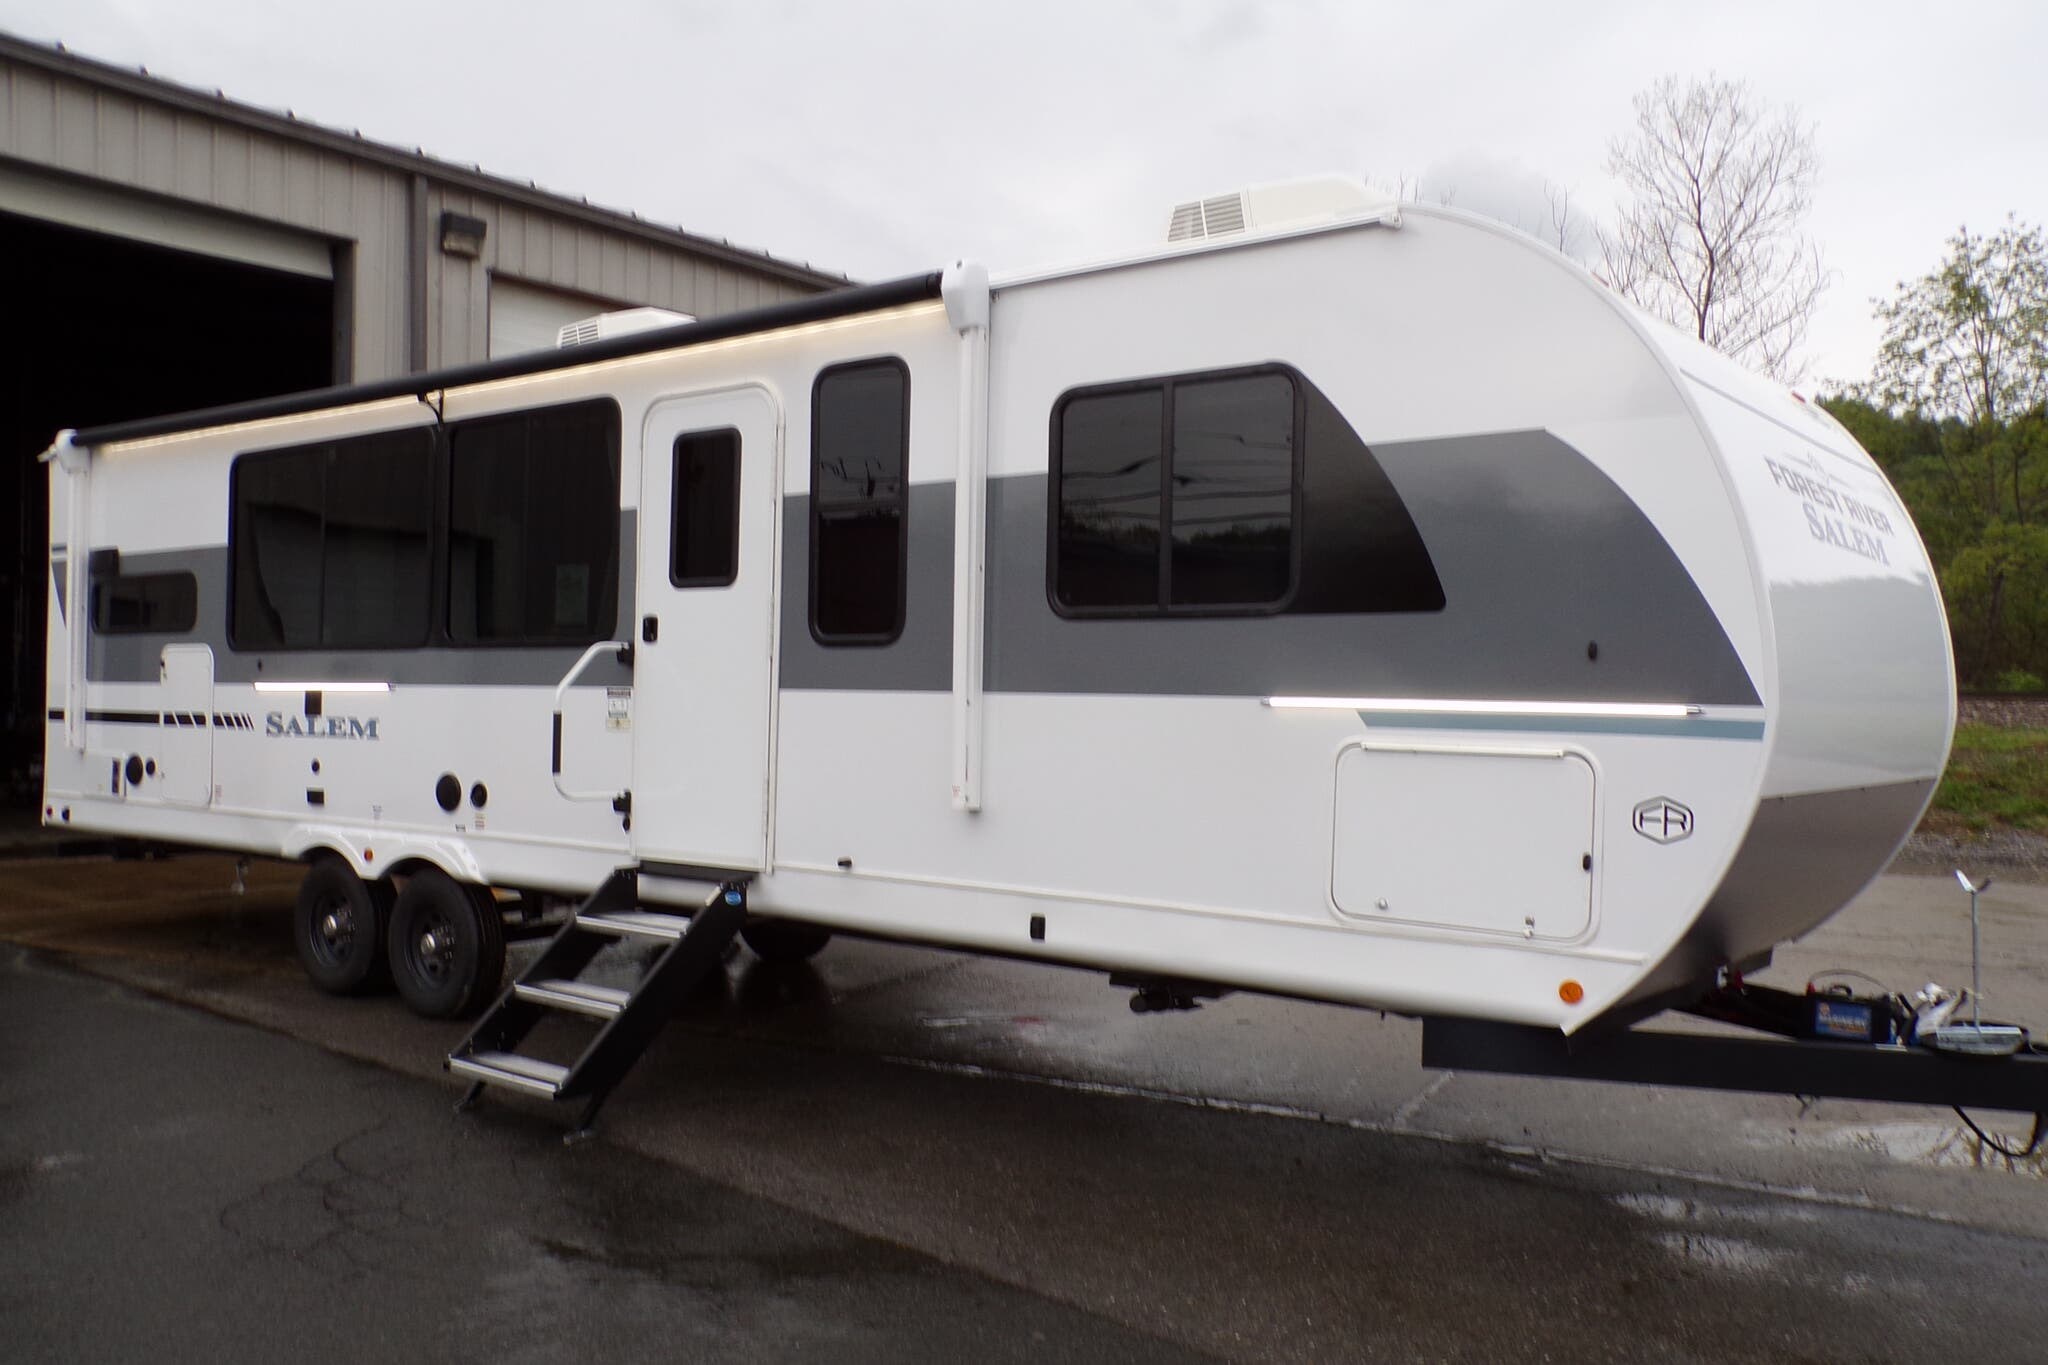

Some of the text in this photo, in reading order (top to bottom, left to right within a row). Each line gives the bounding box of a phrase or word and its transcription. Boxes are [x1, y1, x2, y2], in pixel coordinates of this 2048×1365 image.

[1764, 456, 1894, 536] FOREST RIVER
[1802, 501, 1890, 566] SALEM
[266, 712, 379, 740] SALEM
